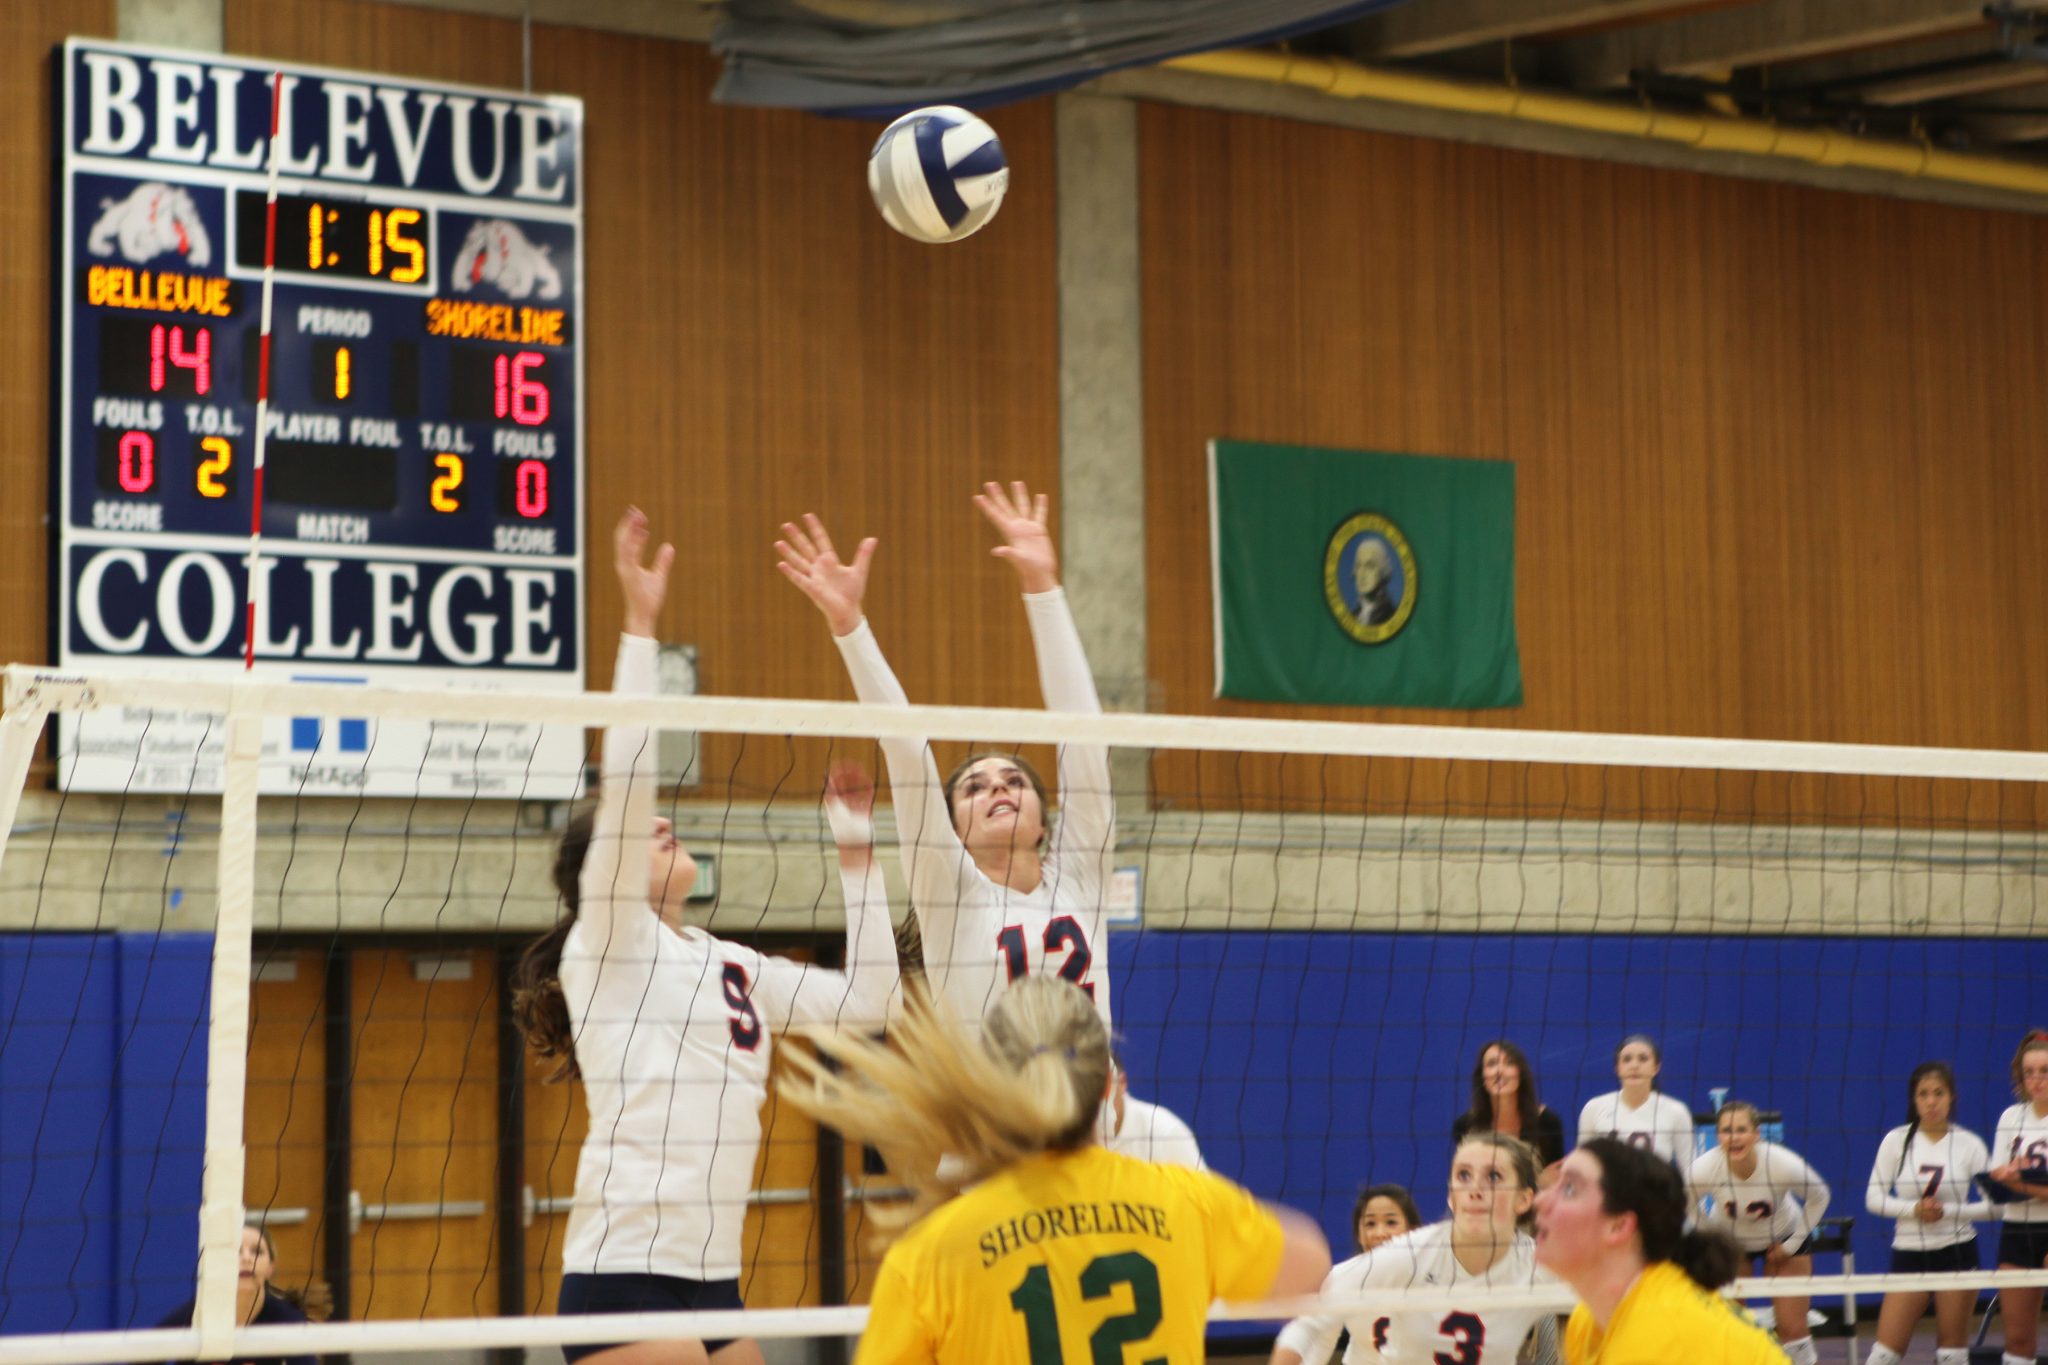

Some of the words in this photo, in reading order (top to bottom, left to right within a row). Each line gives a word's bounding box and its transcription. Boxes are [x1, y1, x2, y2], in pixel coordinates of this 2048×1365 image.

[82, 52, 566, 202] BELLEVUE
[309, 203, 425, 283] 1:15
[88, 265, 232, 316] BELLEVUE
[298, 306, 372, 338] PERIOD
[426, 298, 565, 346] SHORELINE
[150, 323, 211, 395] 14
[335, 347, 350, 400] 1
[93, 397, 164, 430] FOULS
[494, 351, 550, 426] 16
[265, 410, 341, 444] PLAYER
[351, 417, 402, 448] FOUL
[493, 428, 556, 459] FOULS
[119, 430, 154, 493] 0
[197, 435, 232, 498] 2
[430, 453, 463, 513] 2
[516, 459, 548, 518] 0
[92, 501, 164, 531] SCORE
[297, 513, 369, 543] MATCH
[494, 525, 556, 554] SCORE
[76, 547, 561, 666] COLLEGE
[289, 764, 370, 787] NetApp
[997, 915, 1095, 1003] 12
[721, 961, 761, 1053] 9
[1919, 1165, 1944, 1200] 7
[979, 1202, 1172, 1270] SHORELINE
[1010, 1250, 1168, 1365] 12
[1434, 1311, 1486, 1365] 3
